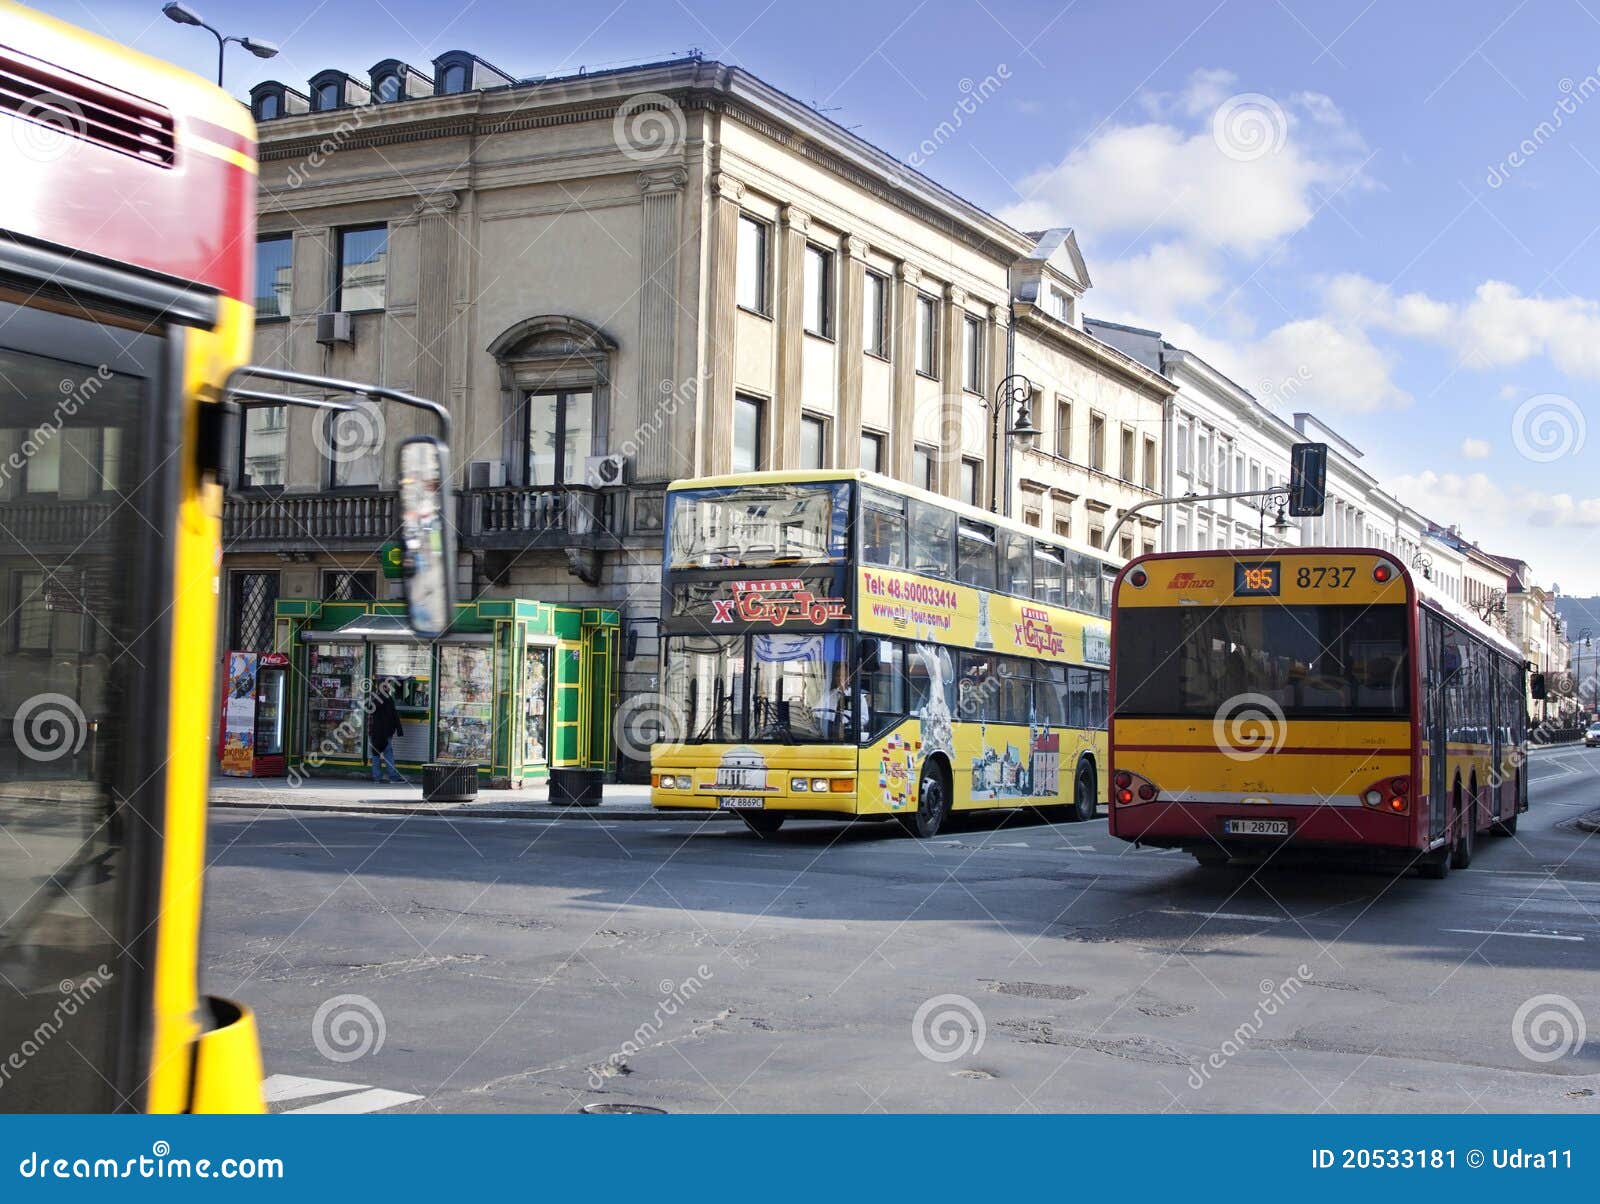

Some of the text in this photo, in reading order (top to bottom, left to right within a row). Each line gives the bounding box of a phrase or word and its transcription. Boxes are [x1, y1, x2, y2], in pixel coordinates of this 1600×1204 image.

[864, 573, 886, 595] Tel:
[1244, 569, 1273, 590] 195
[1296, 567, 1357, 589] 8737
[872, 602, 951, 631] www.citytour.com.pl
[723, 798, 736, 808] WZ
[1230, 821, 1287, 834] WI 28702
